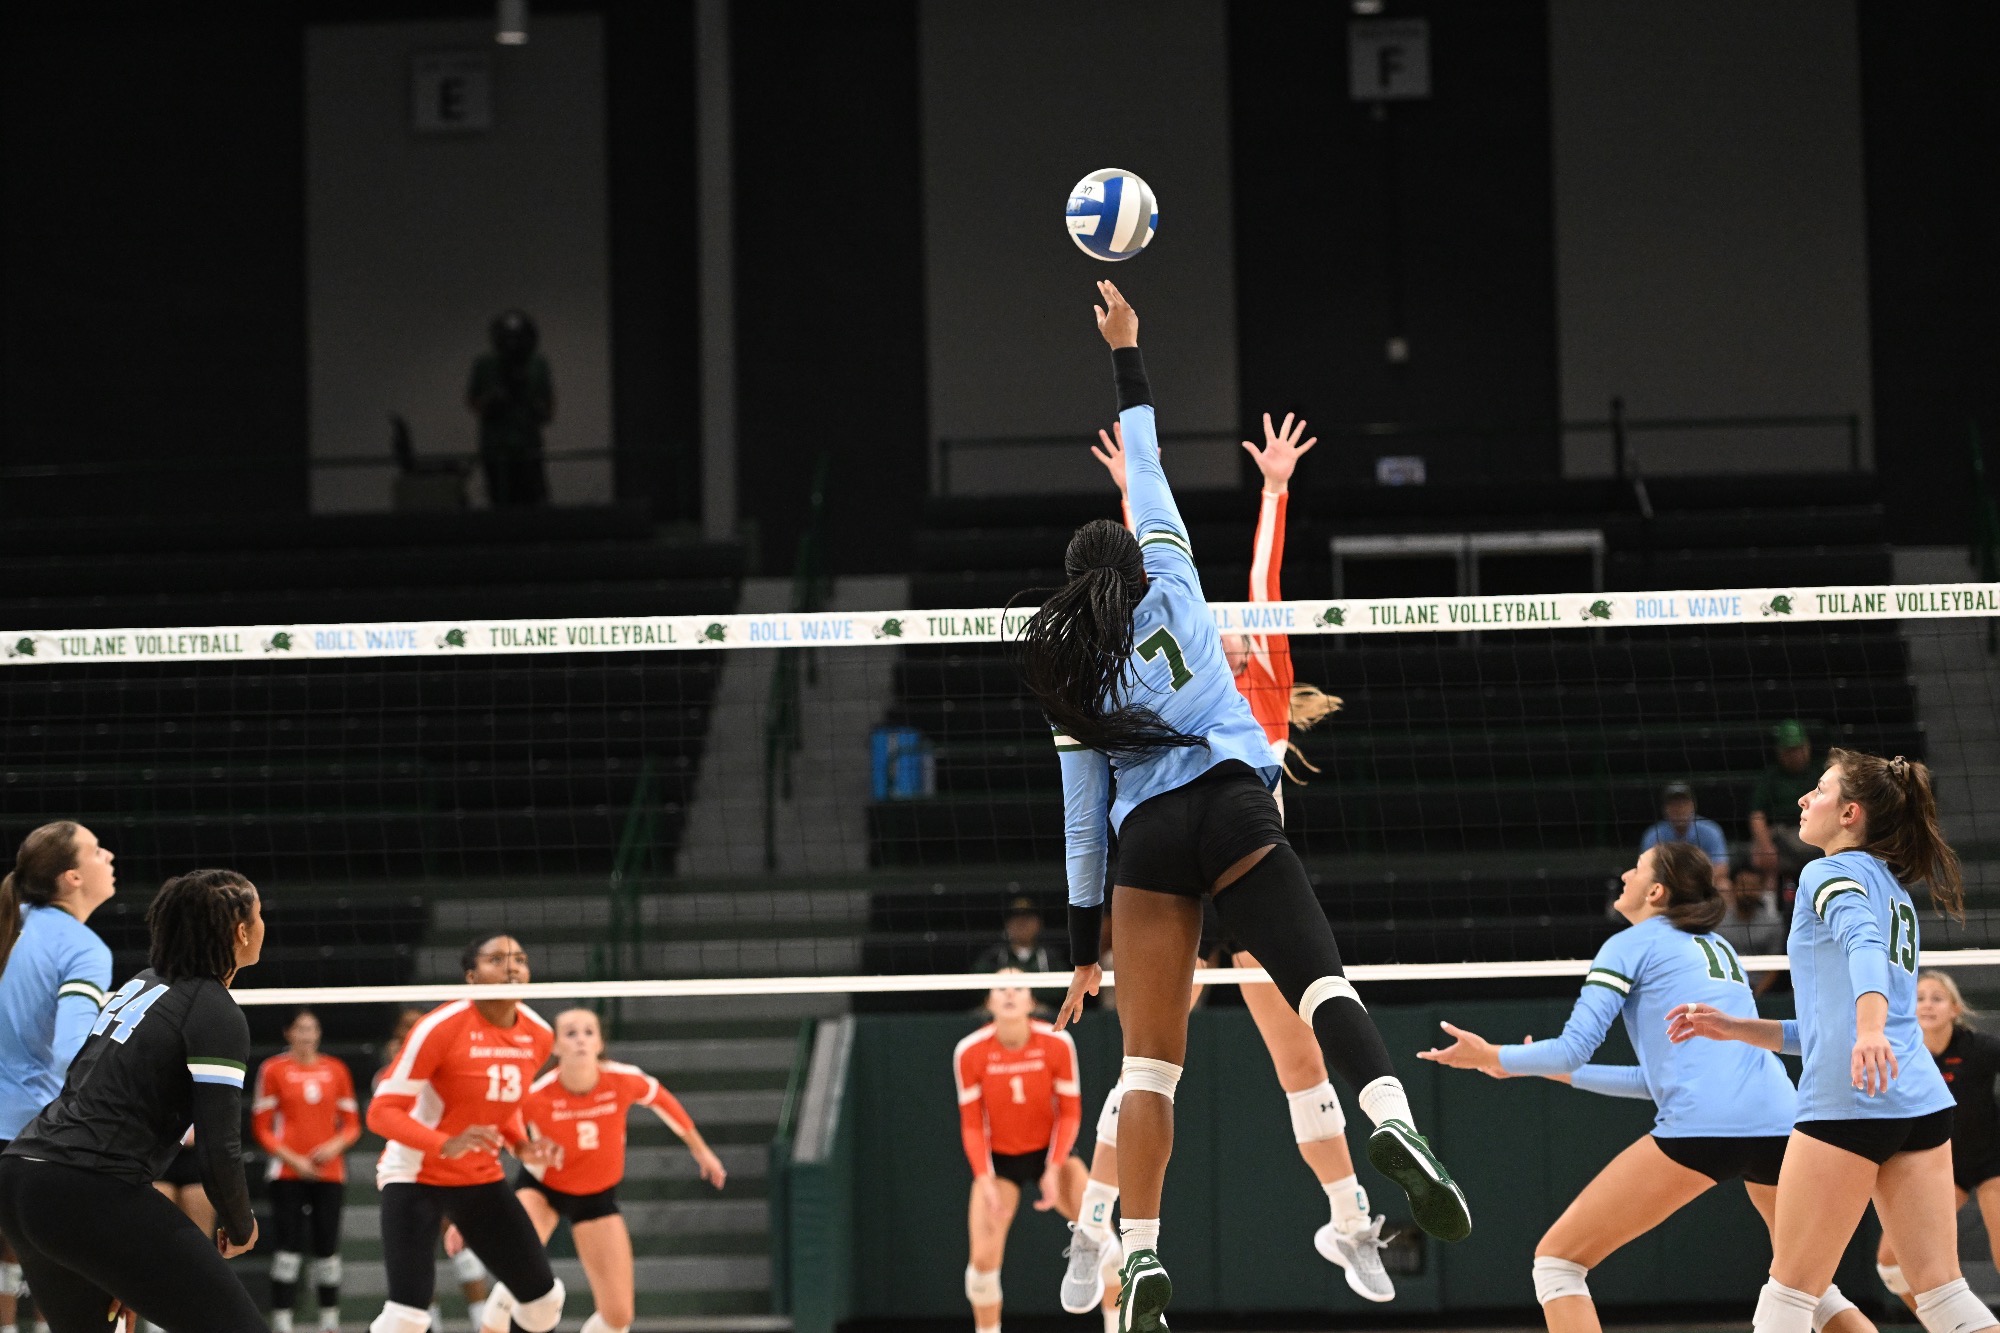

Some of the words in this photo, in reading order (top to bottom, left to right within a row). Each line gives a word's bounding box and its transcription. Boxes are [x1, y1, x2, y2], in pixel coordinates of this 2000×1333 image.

[1378, 45, 1405, 88] F
[439, 77, 465, 119] E
[1368, 605, 1439, 625] TULANE
[1448, 602, 1561, 623] VOLLEYBALL
[1635, 599, 1679, 618] ROLL
[1688, 596, 1742, 617] WAVE
[1815, 593, 1887, 613] TULANE
[1895, 589, 2000, 612] VOLLEYBAL
[749, 622, 792, 642] ROLL
[801, 620, 853, 640] WAVE
[927, 616, 996, 636] TULANE
[1212, 608, 1234, 629] LL
[1241, 607, 1295, 628] WAVE
[60, 636, 126, 656] TULANE
[135, 634, 243, 655] VOLLEYBALL
[315, 631, 356, 650] ROLL
[366, 629, 418, 649] WAVE
[490, 626, 558, 647] TULANE
[567, 624, 677, 646] VOLLEYBALL
[1134, 624, 1194, 692] 7
[1888, 896, 1917, 976] 13
[1693, 935, 1747, 986] 11
[89, 978, 170, 1045] 24
[485, 1063, 522, 1103] 13
[1008, 1073, 1026, 1104] 1
[576, 1119, 600, 1151] 2
